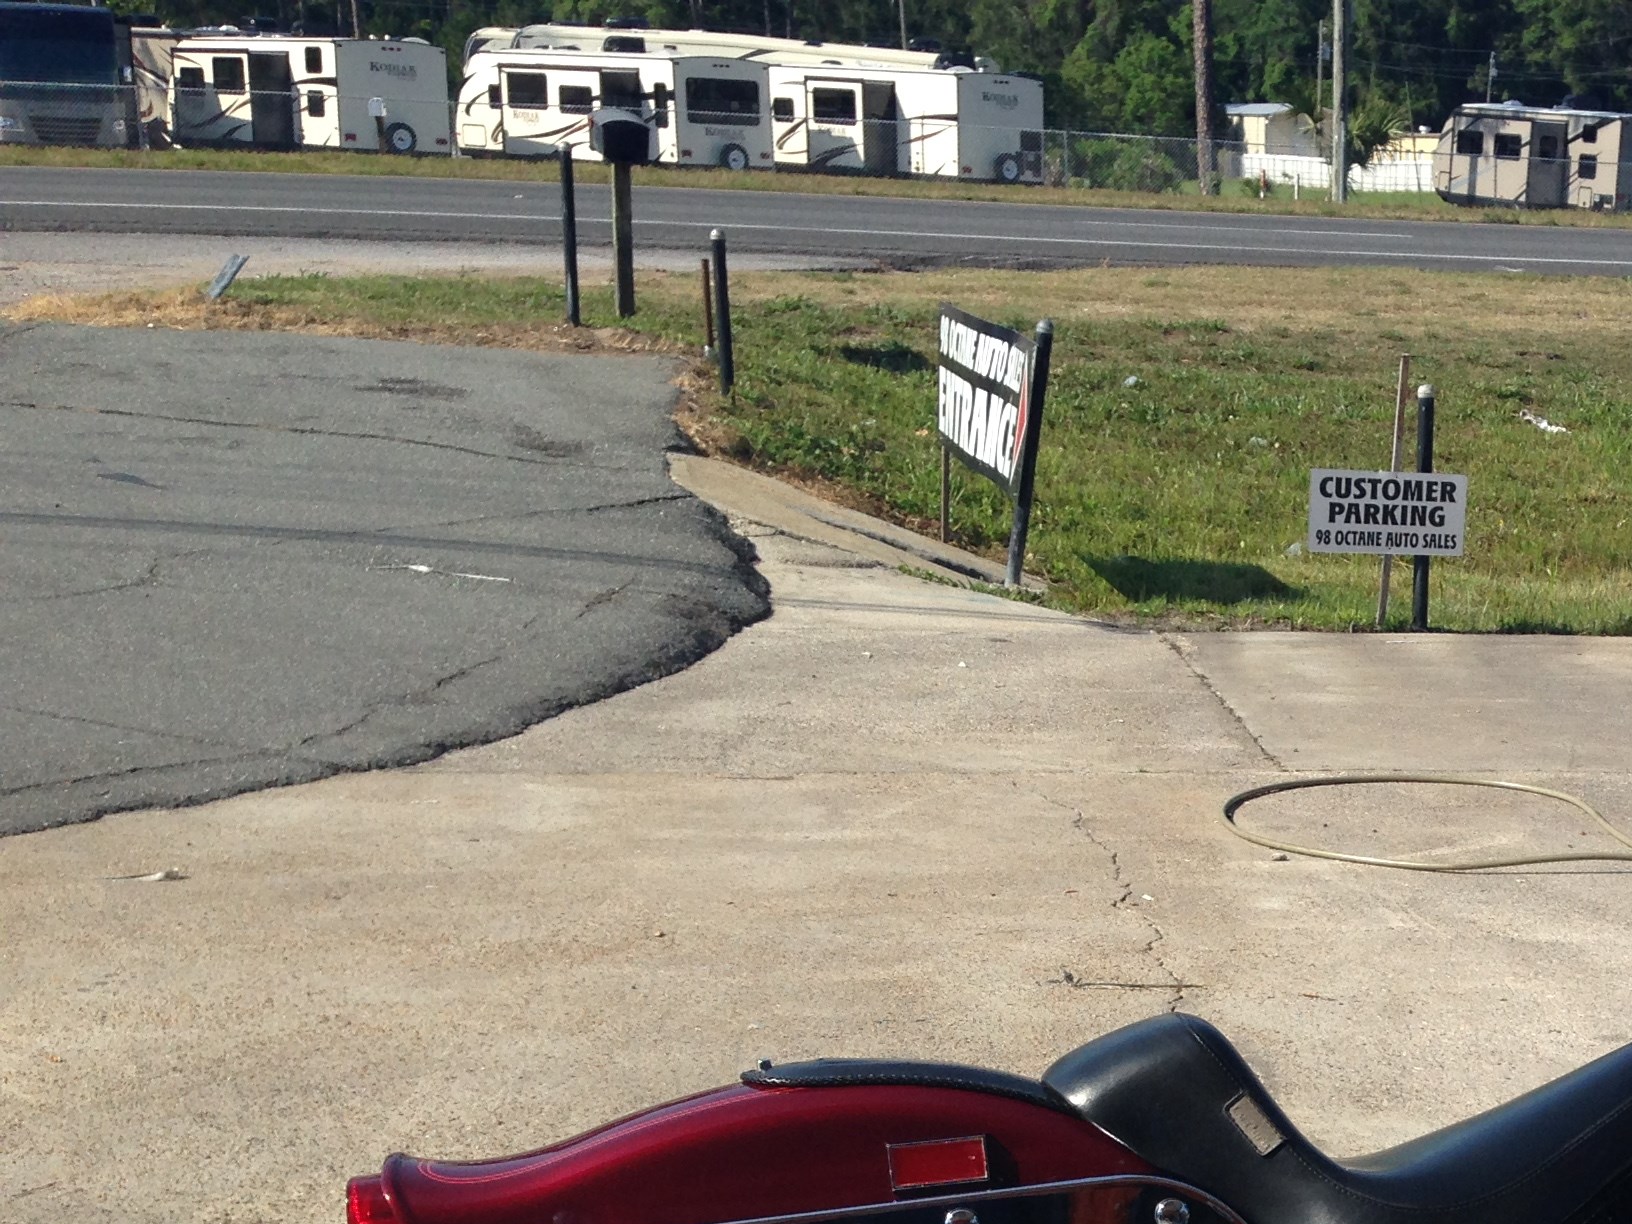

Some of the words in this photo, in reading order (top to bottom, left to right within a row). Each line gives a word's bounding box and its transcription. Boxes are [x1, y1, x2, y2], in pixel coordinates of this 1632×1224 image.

[974, 332, 1008, 382] AUTO
[939, 364, 1018, 479] ENTRANCE
[1319, 476, 1456, 503] CUSTOMER
[1328, 501, 1446, 527] PARKING
[1315, 529, 1331, 545] 98
[1334, 530, 1382, 547] OCTANE
[1385, 531, 1419, 548] AUTO
[1422, 533, 1457, 550] SALES
